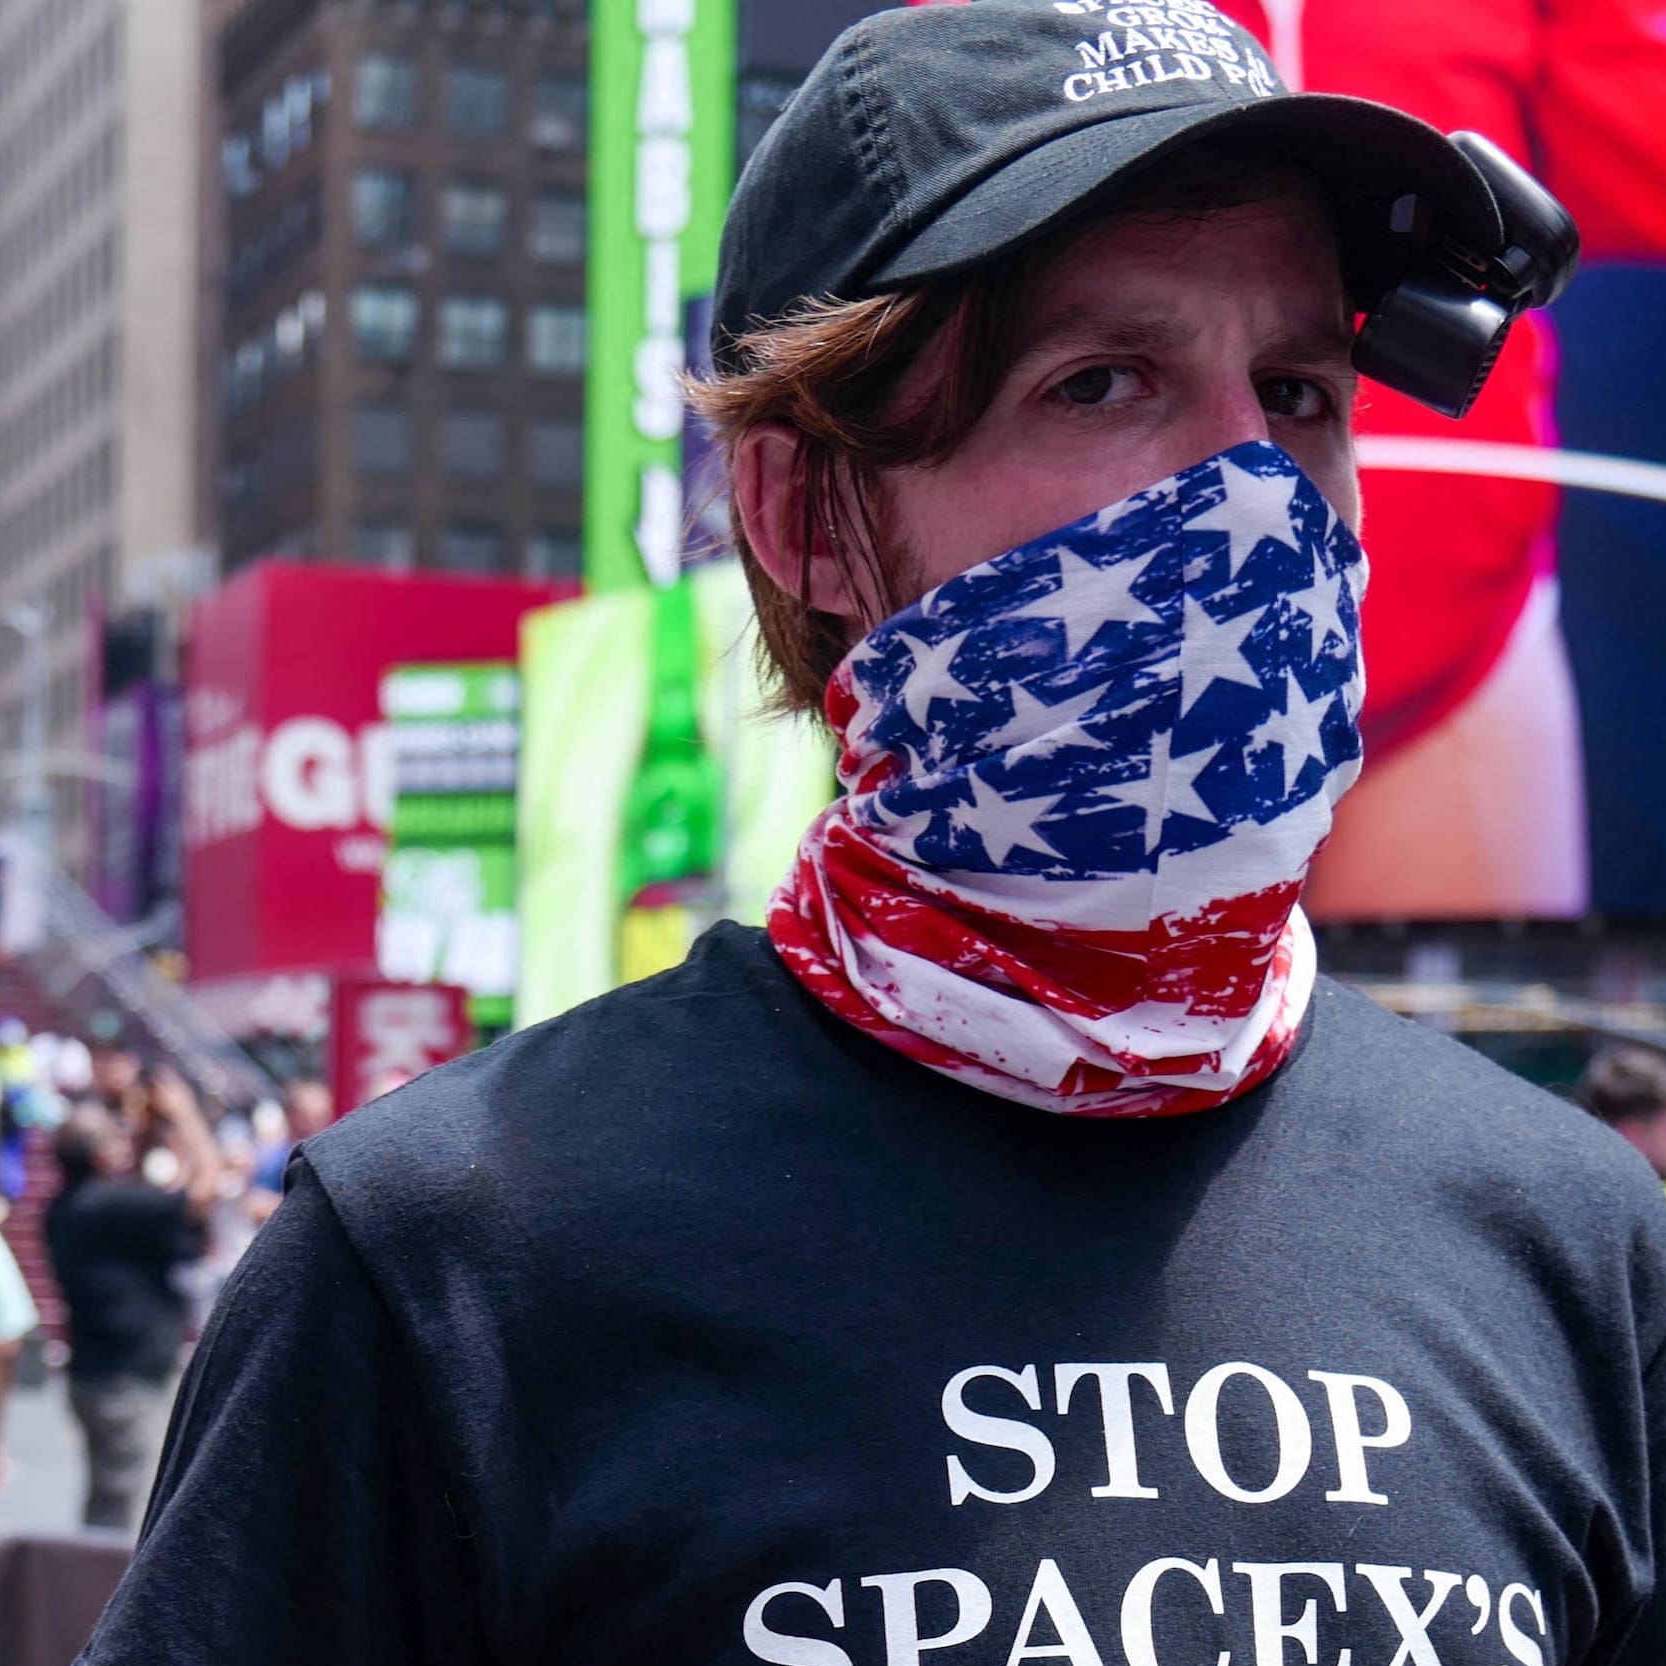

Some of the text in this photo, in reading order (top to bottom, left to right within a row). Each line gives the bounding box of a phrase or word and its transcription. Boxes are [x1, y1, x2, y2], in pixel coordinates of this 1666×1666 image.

[1106, 6, 1231, 37] GROK
[1075, 26, 1239, 69] MAKES
[1063, 53, 1212, 101] CHILD
[940, 1361, 1412, 1507] STOP
